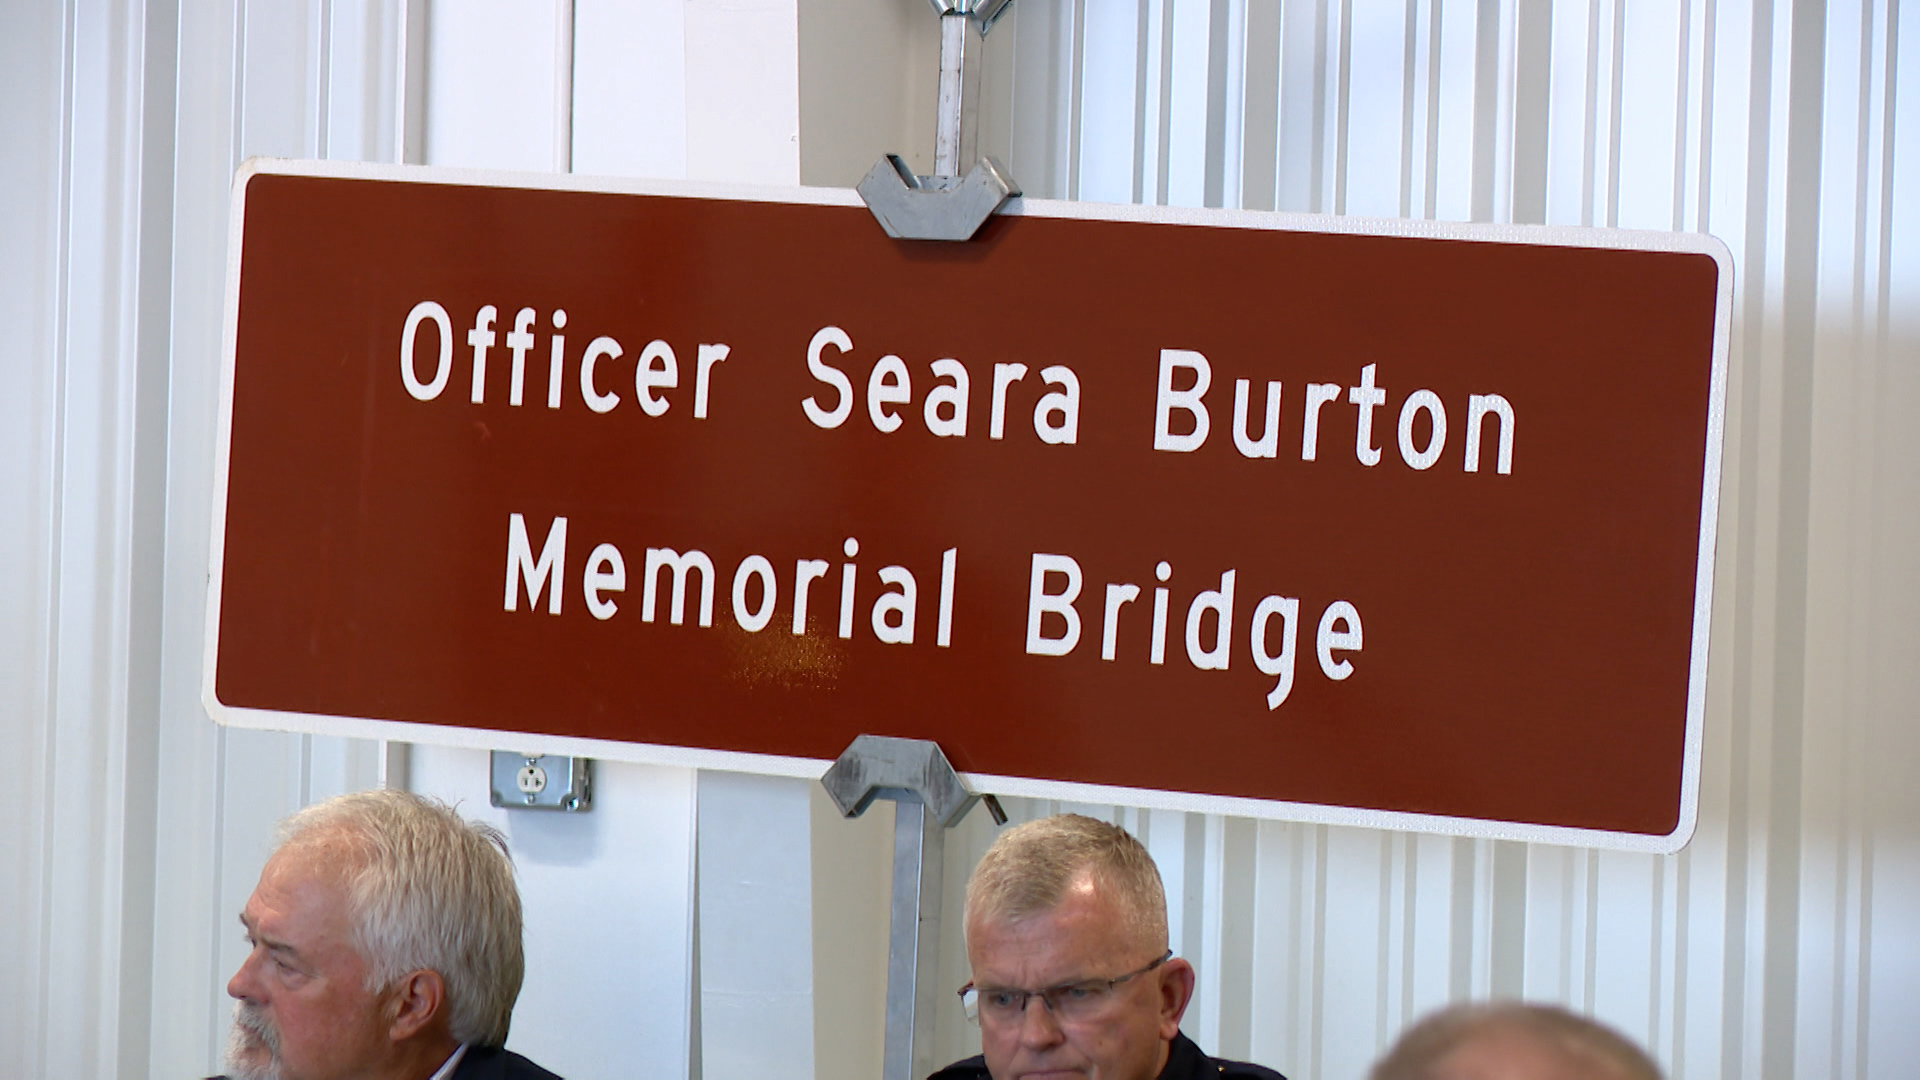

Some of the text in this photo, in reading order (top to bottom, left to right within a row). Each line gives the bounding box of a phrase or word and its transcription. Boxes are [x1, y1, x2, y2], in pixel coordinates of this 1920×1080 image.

[400, 300, 1517, 477] Officer Seara Burton
[503, 512, 1364, 711] Memorial Bridge
